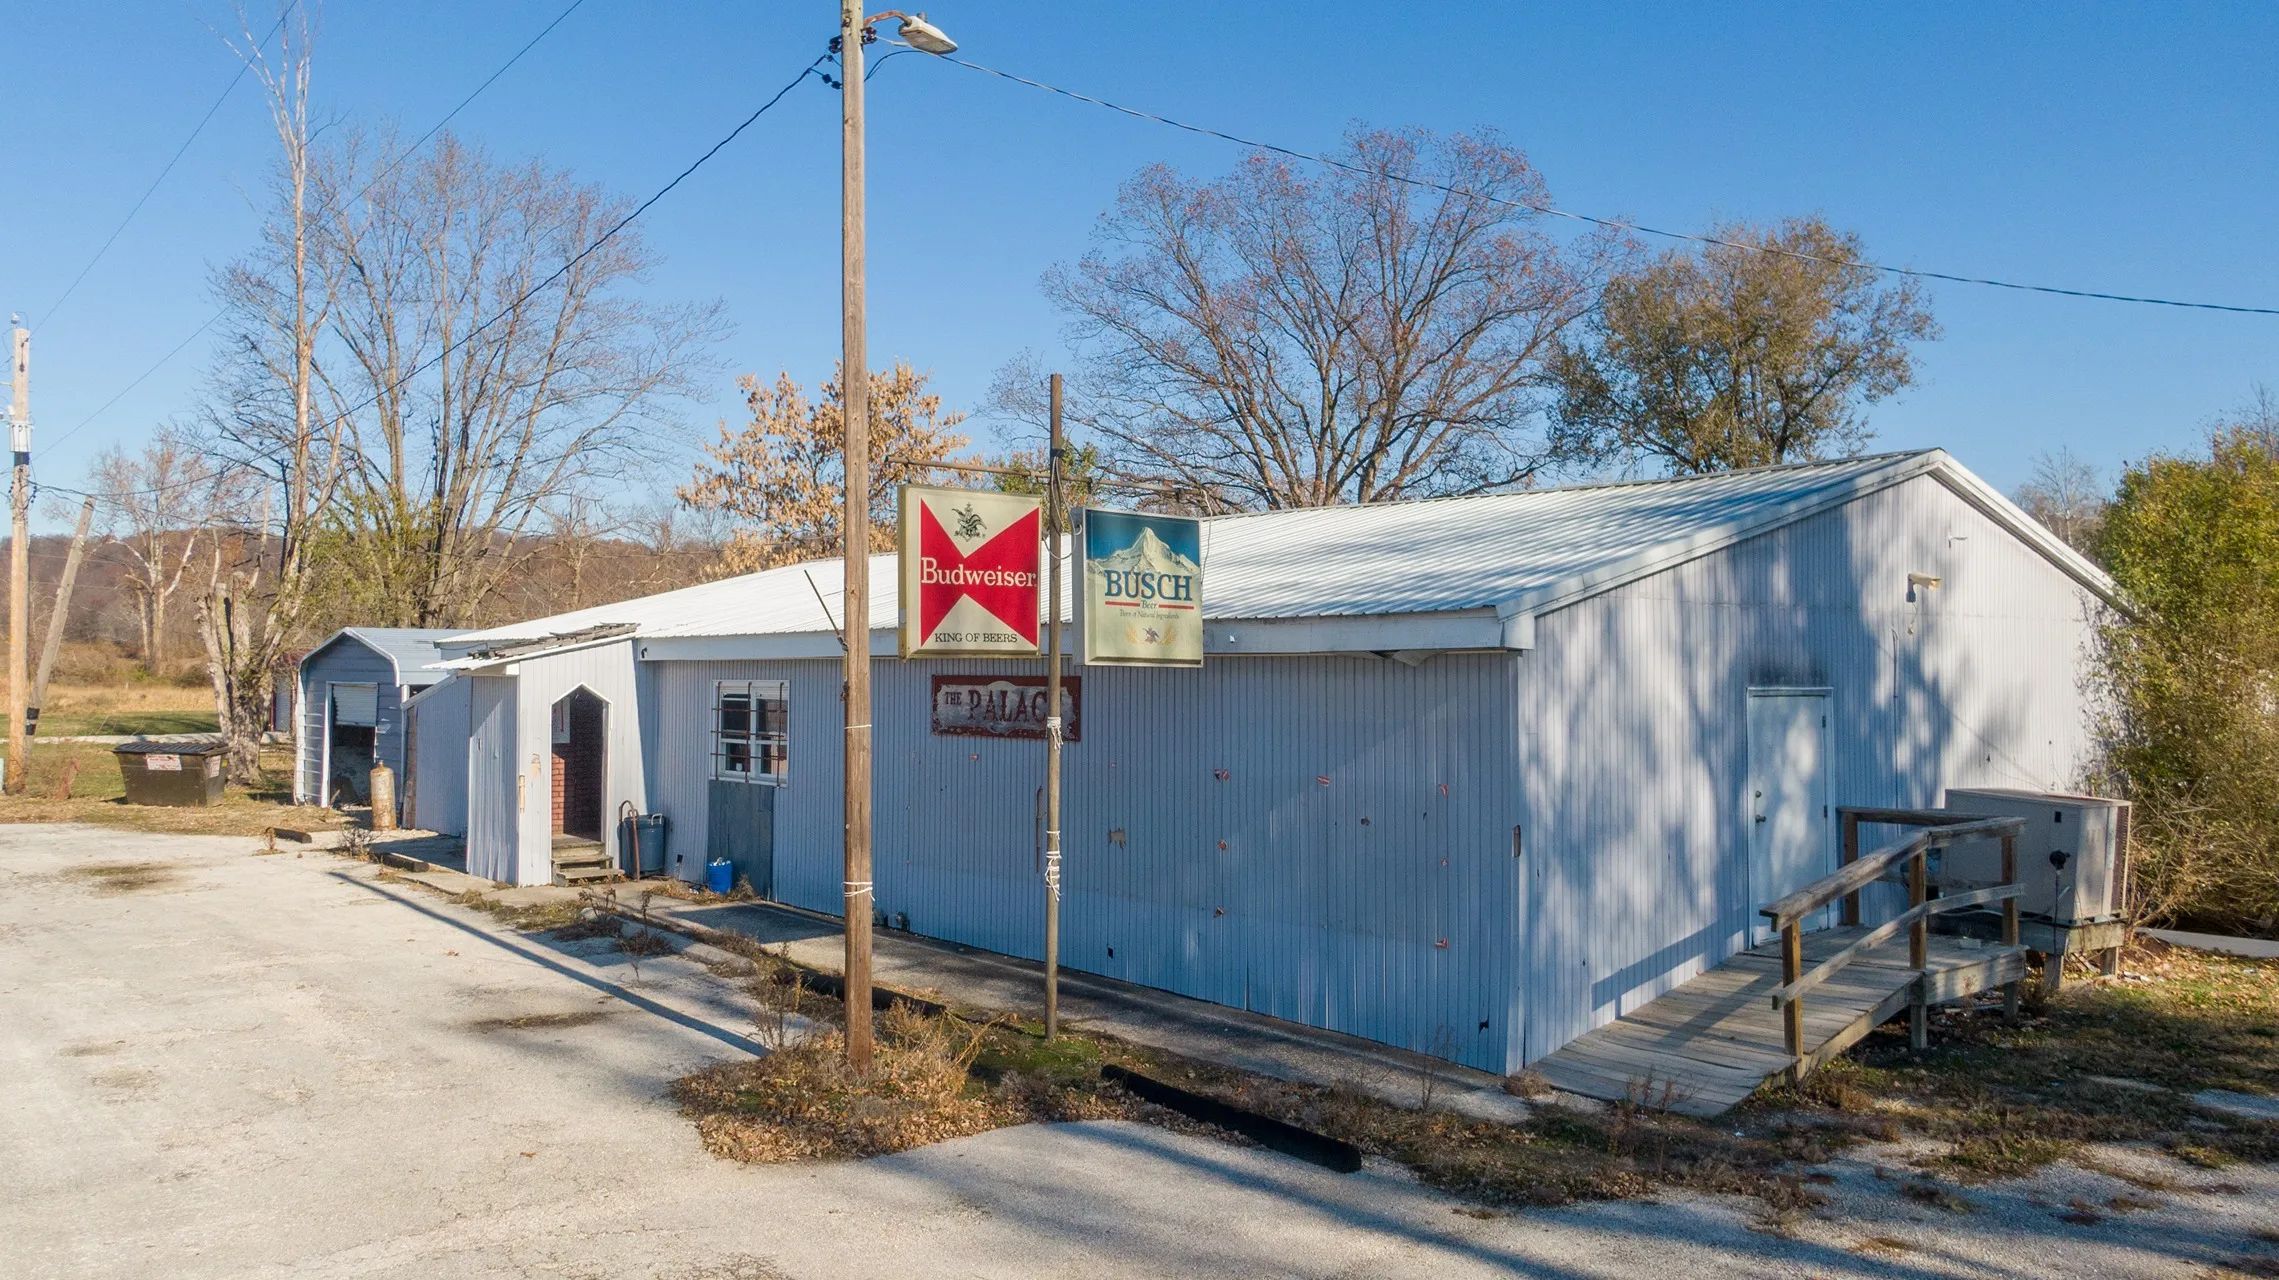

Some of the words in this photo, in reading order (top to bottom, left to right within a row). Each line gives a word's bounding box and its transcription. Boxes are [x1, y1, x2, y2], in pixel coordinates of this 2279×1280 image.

[921, 556, 1036, 587] Budweiser
[1104, 569, 1193, 601] BUSCH
[1141, 599, 1157, 609] Beer
[935, 632, 962, 643] KING
[965, 632, 980, 643] OF
[983, 632, 1018, 643] BEERS
[944, 691, 962, 706] THE
[968, 689, 1048, 723] PALAC
